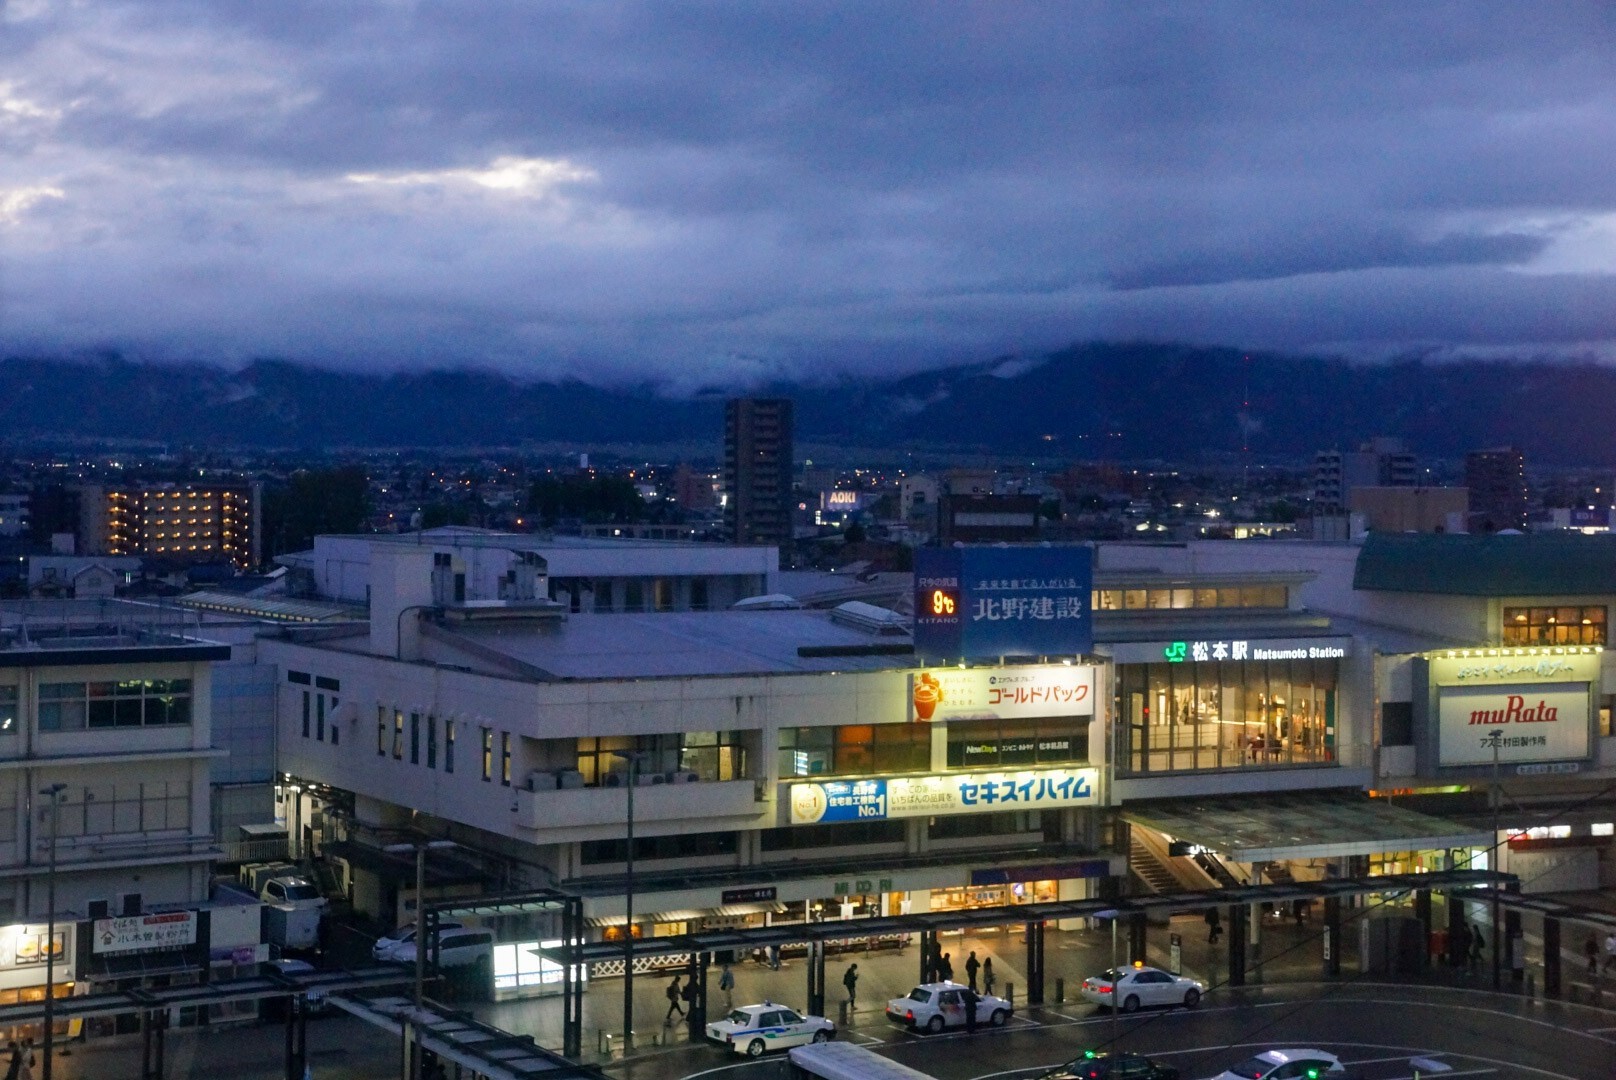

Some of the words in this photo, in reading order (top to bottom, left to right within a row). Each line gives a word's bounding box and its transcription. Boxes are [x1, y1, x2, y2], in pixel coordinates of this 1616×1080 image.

[829, 492, 856, 503] AOKI
[972, 596, 1082, 621] 北野建設
[1165, 642, 1186, 657] JR
[1193, 641, 1248, 661] 松本駅
[1253, 648, 1307, 660] Matsumoto
[1309, 647, 1344, 658] Station
[988, 685, 1088, 704] ゴールドパック
[1468, 695, 1558, 725] muRata
[966, 745, 997, 754] NewDays
[959, 776, 1091, 805] セキスイハイム
[858, 794, 885, 817] No.1
